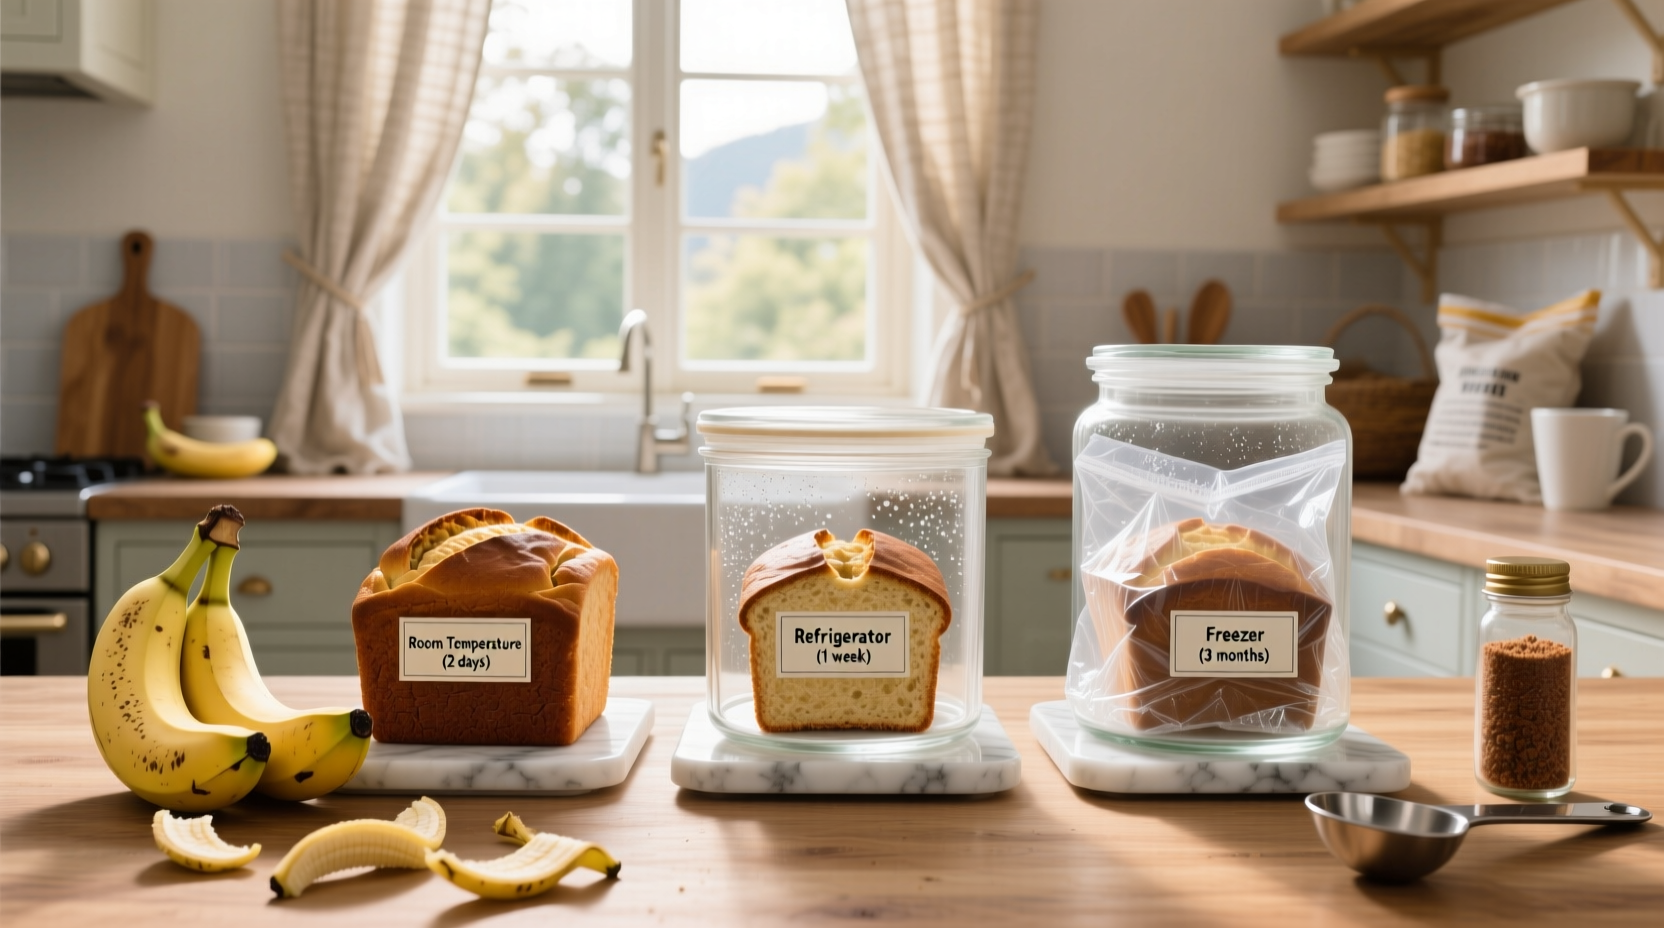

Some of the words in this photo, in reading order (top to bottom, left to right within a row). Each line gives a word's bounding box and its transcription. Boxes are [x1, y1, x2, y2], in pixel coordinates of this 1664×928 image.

[409, 636, 443, 649] Room
[795, 628, 891, 648] Refrigerator
[1206, 627, 1264, 642] Freezer
[442, 654, 455, 671] (2
[458, 654, 491, 672] days)
[816, 648, 827, 665] (1
[832, 648, 871, 665] week)
[1199, 647, 1212, 664] (3
[1217, 647, 1269, 664] months)
